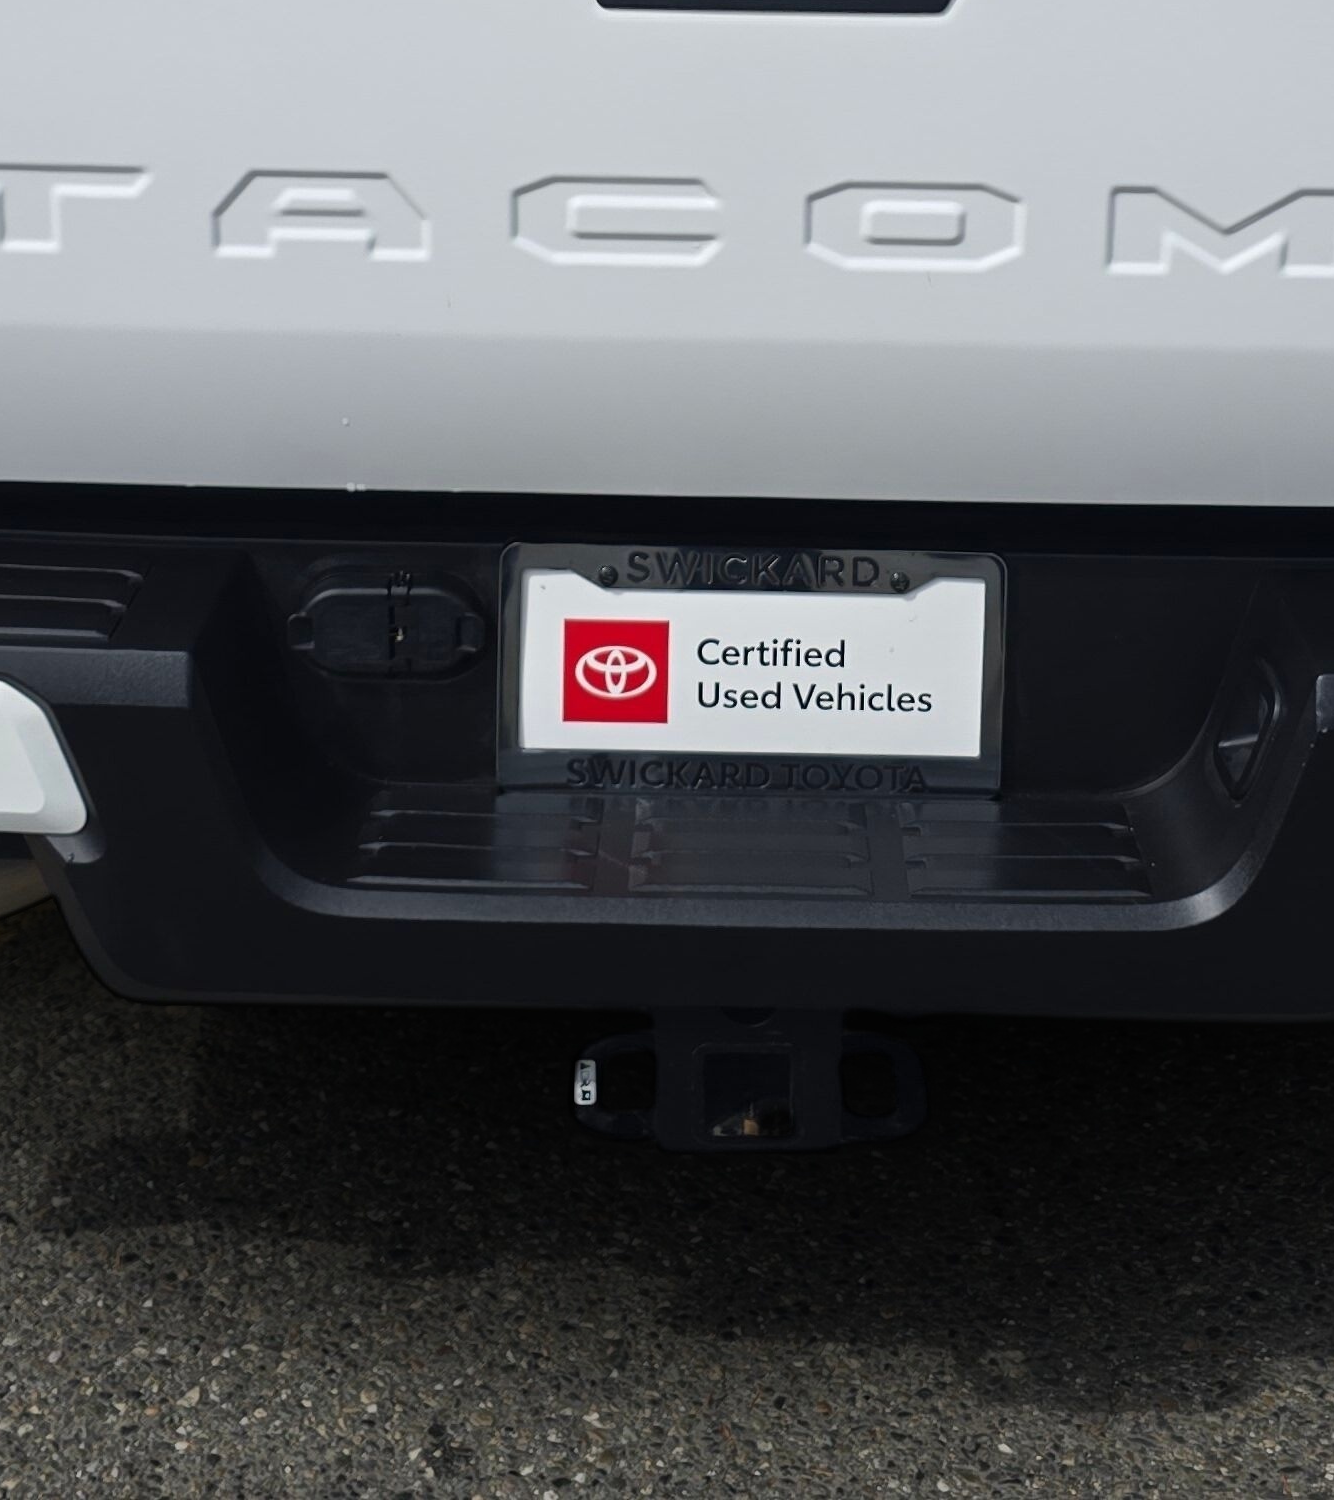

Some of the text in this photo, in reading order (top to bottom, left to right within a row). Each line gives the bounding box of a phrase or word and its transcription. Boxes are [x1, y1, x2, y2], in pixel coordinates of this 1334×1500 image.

[626, 551, 880, 588] SWICKARD
[696, 638, 846, 669] Certified
[696, 681, 933, 713] Used Vehicles
[566, 757, 929, 793] SWICKARD TOYOTA
